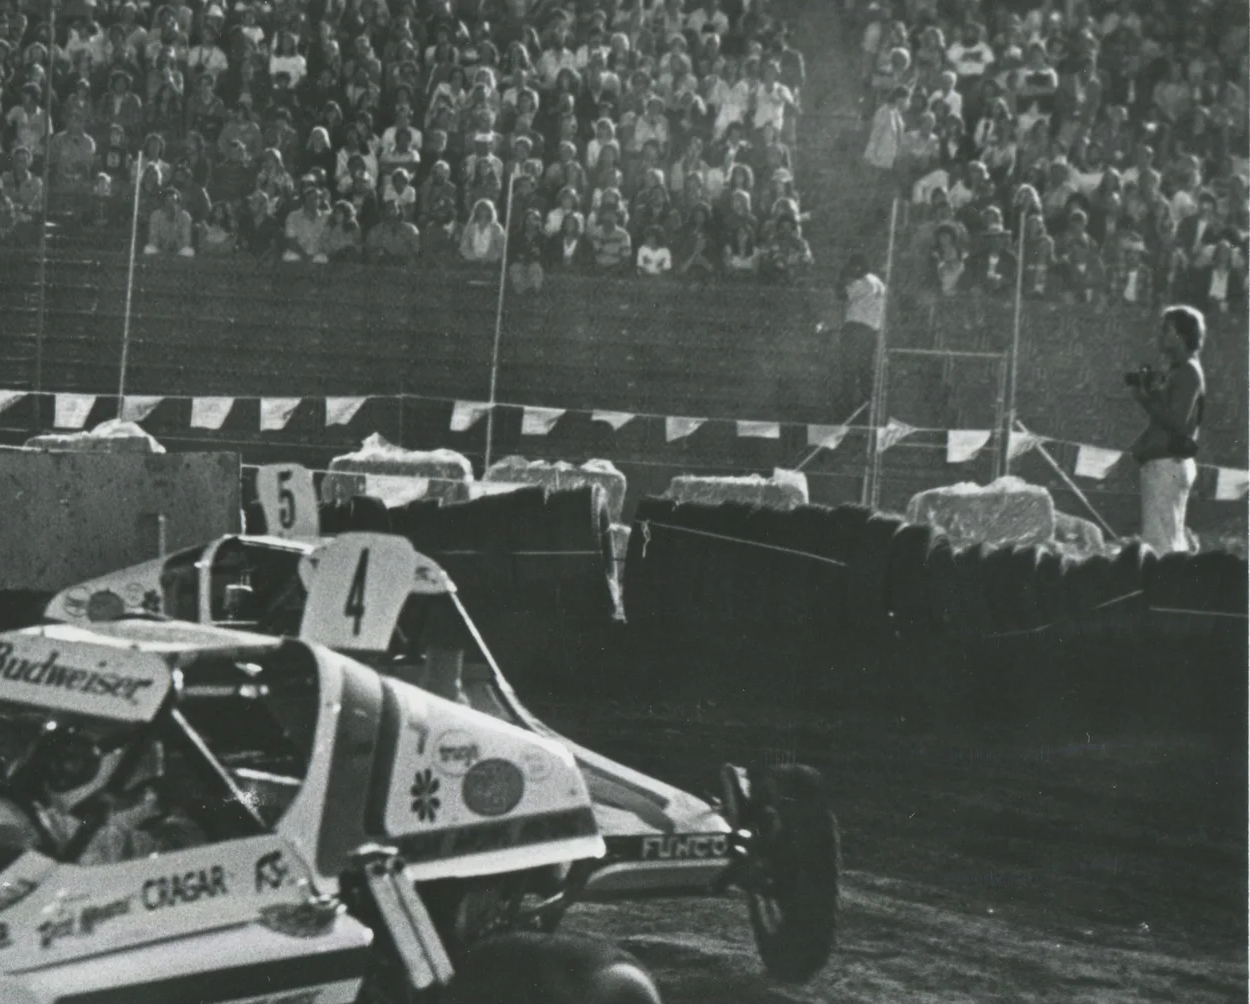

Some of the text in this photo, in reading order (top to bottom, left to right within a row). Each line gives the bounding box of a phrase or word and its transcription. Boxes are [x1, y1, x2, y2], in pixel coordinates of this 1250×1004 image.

[276, 469, 296, 529] 5
[344, 546, 369, 637] 4
[641, 832, 729, 859] FUNCO
[141, 864, 228, 910] CRAGAR
